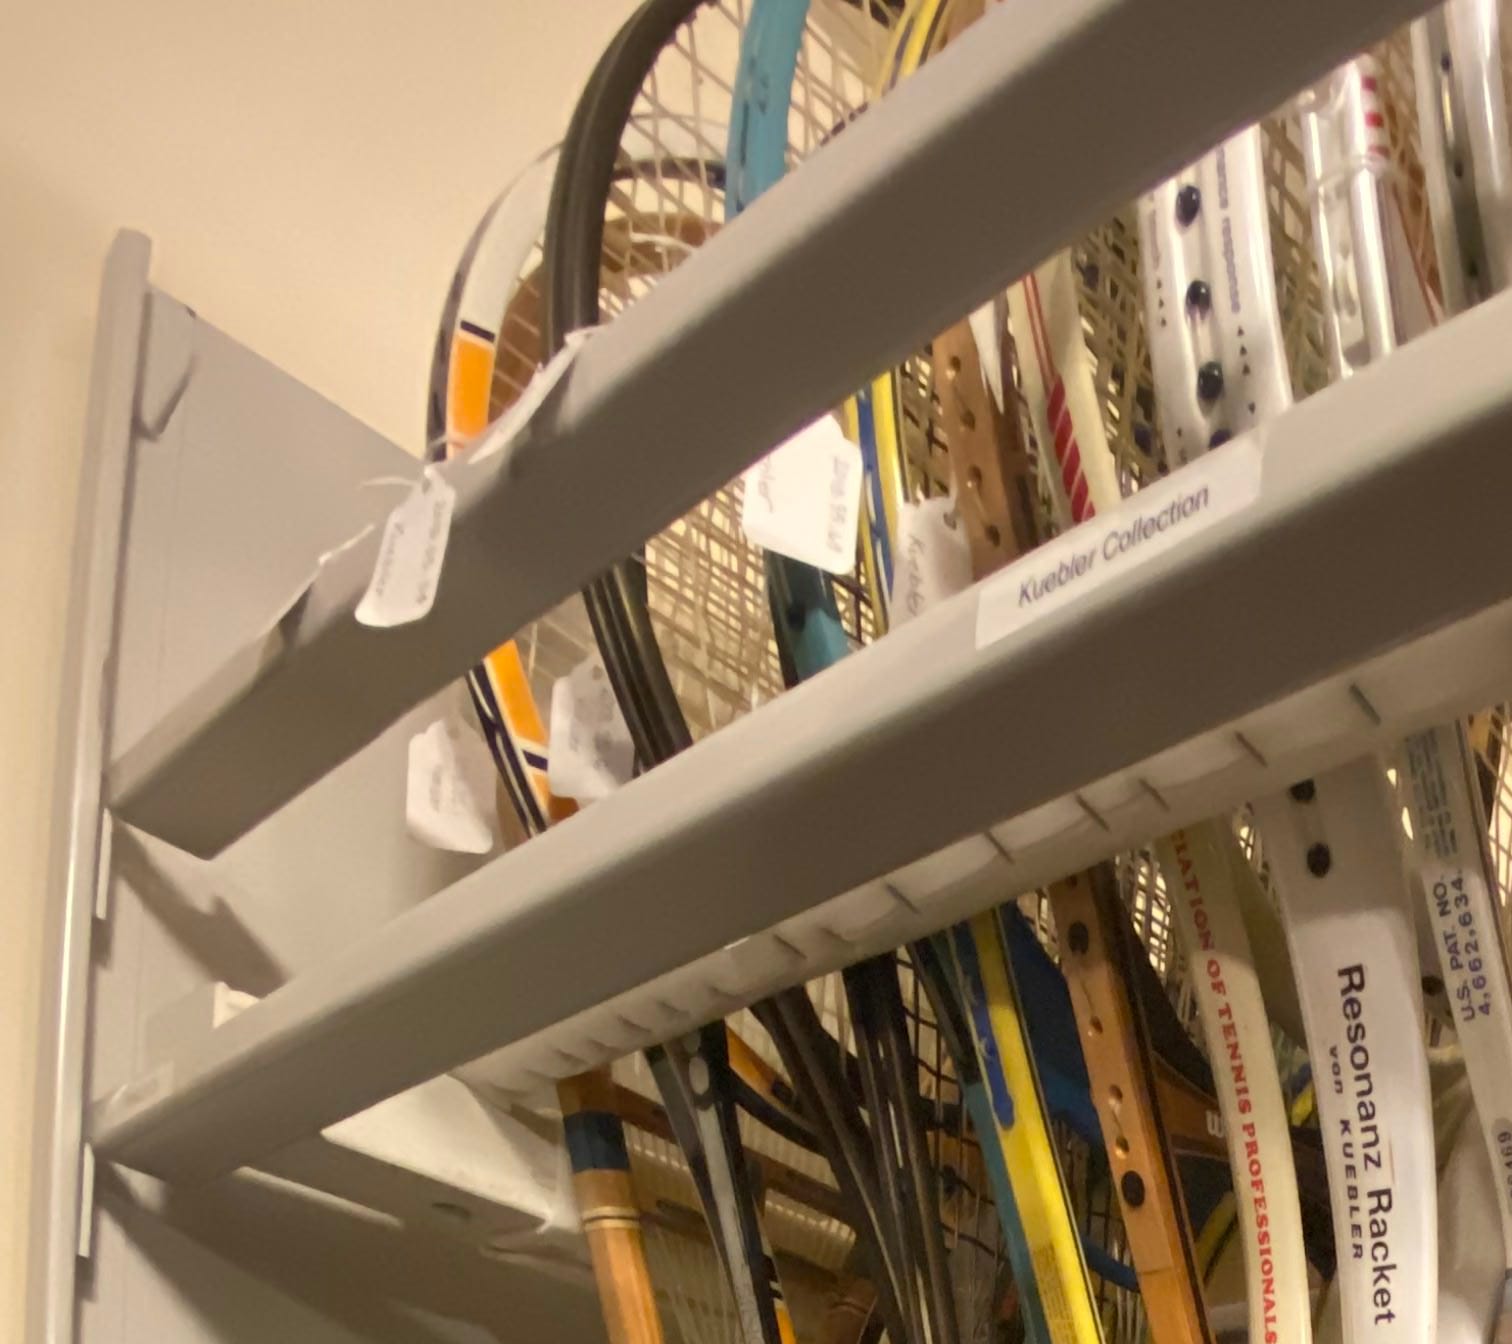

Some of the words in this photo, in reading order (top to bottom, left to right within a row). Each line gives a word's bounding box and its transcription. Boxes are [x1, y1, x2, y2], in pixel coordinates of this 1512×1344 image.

[1018, 547, 1096, 608] Kuebler
[1102, 485, 1210, 562] Collection
[1206, 958, 1227, 998] OF
[1216, 1002, 1254, 1115] TENNIS
[1329, 1044, 1344, 1095] von
[1339, 1118, 1364, 1260] KUEBLER
[1336, 963, 1383, 1171] Resonanz
[1366, 1186, 1398, 1325] Racket
